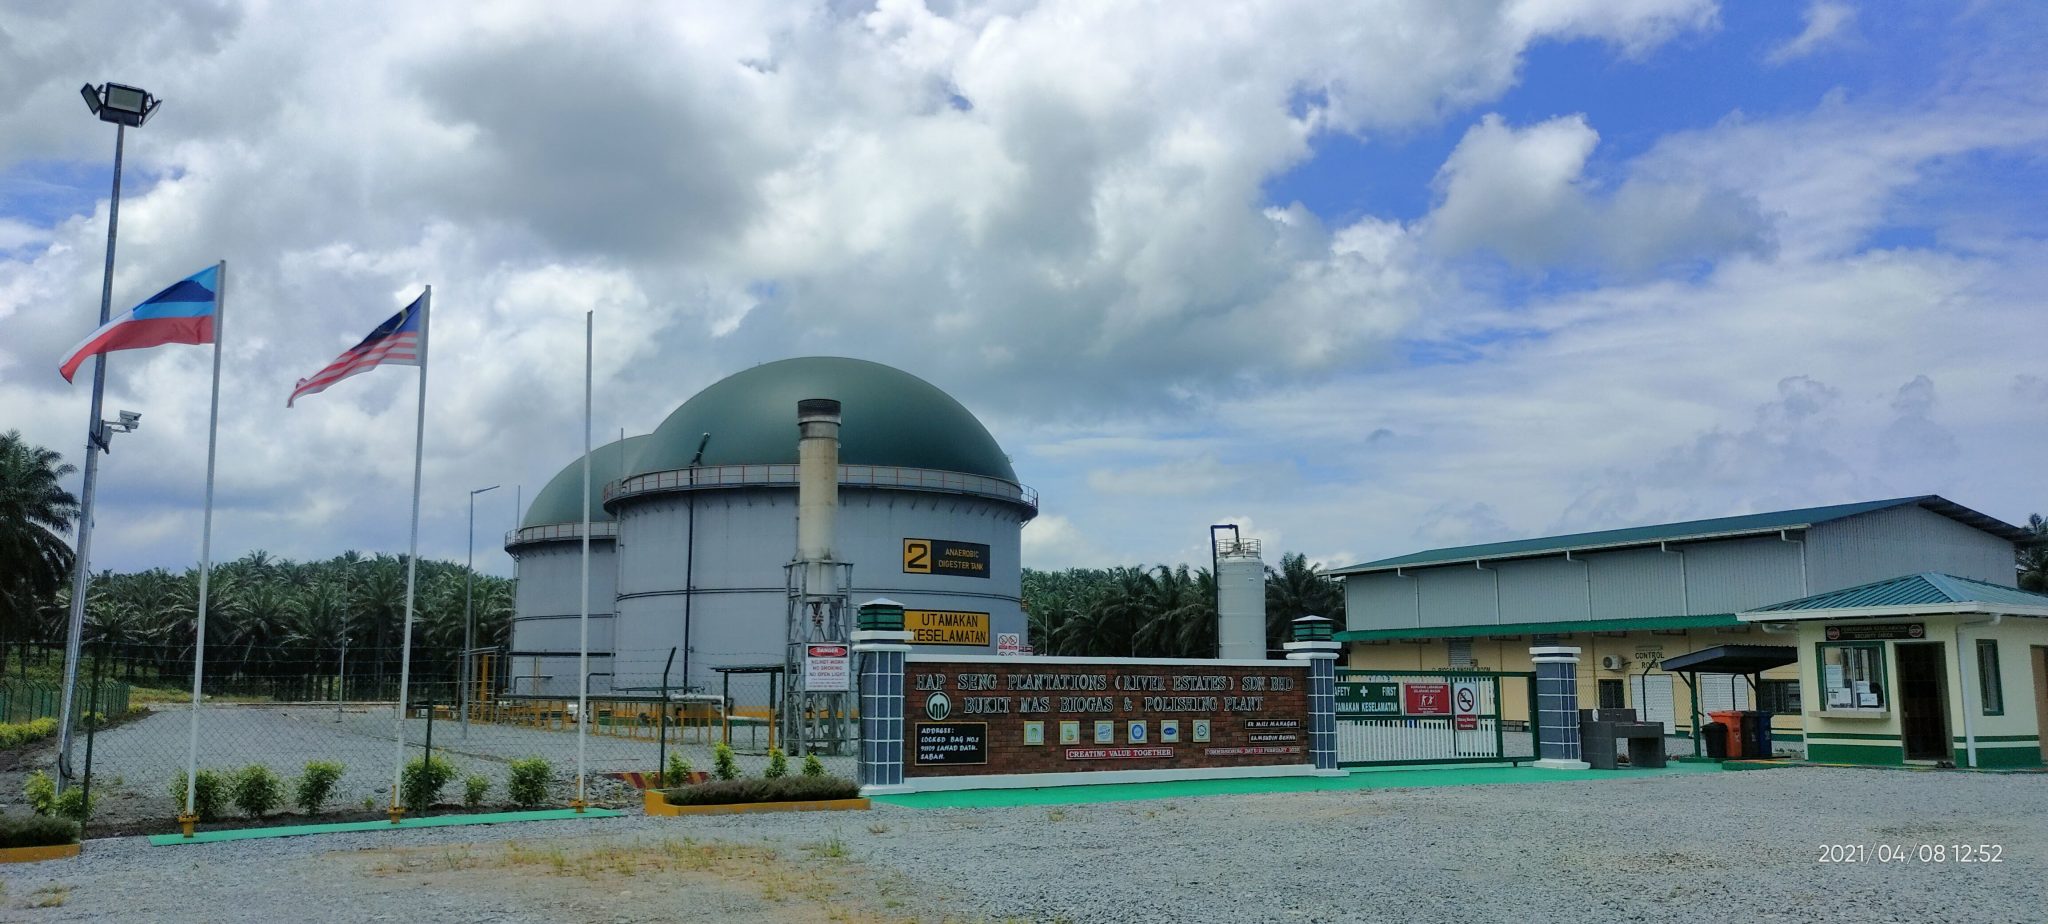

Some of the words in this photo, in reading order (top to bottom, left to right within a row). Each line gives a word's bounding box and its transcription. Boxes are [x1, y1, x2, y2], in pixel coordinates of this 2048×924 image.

[907, 543, 928, 569] 2
[945, 548, 979, 558] ANAEROBIC
[938, 560, 970, 570] DIGESTER
[971, 562, 984, 571] TANK
[921, 613, 978, 627] UTAMAKAN
[909, 629, 986, 643] KESELAMATAN
[915, 674, 946, 691] HAP
[957, 674, 998, 691] SENG
[1007, 674, 1107, 691] PLANTATIONS
[1114, 675, 1166, 691] (RIVER
[1172, 675, 1235, 691] ESTATES)
[1242, 676, 1266, 692] SDN
[1270, 677, 1294, 692] BHD
[1334, 686, 1350, 697] AFETY
[1382, 686, 1397, 697] FIRST
[963, 697, 1011, 714] BUKIT
[1019, 697, 1050, 713] MAS
[1060, 697, 1113, 713] BIOGAS
[1123, 698, 1133, 711] &
[1144, 696, 1218, 712] POLISHING
[1224, 697, 1264, 711] PLANT
[1335, 702, 1359, 712] TAMAKAN
[1361, 701, 1398, 712] KESELAMATAN
[1069, 750, 1106, 758] CREATING
[1108, 749, 1131, 757] VALUE
[1133, 748, 1172, 756] TOGETHER
